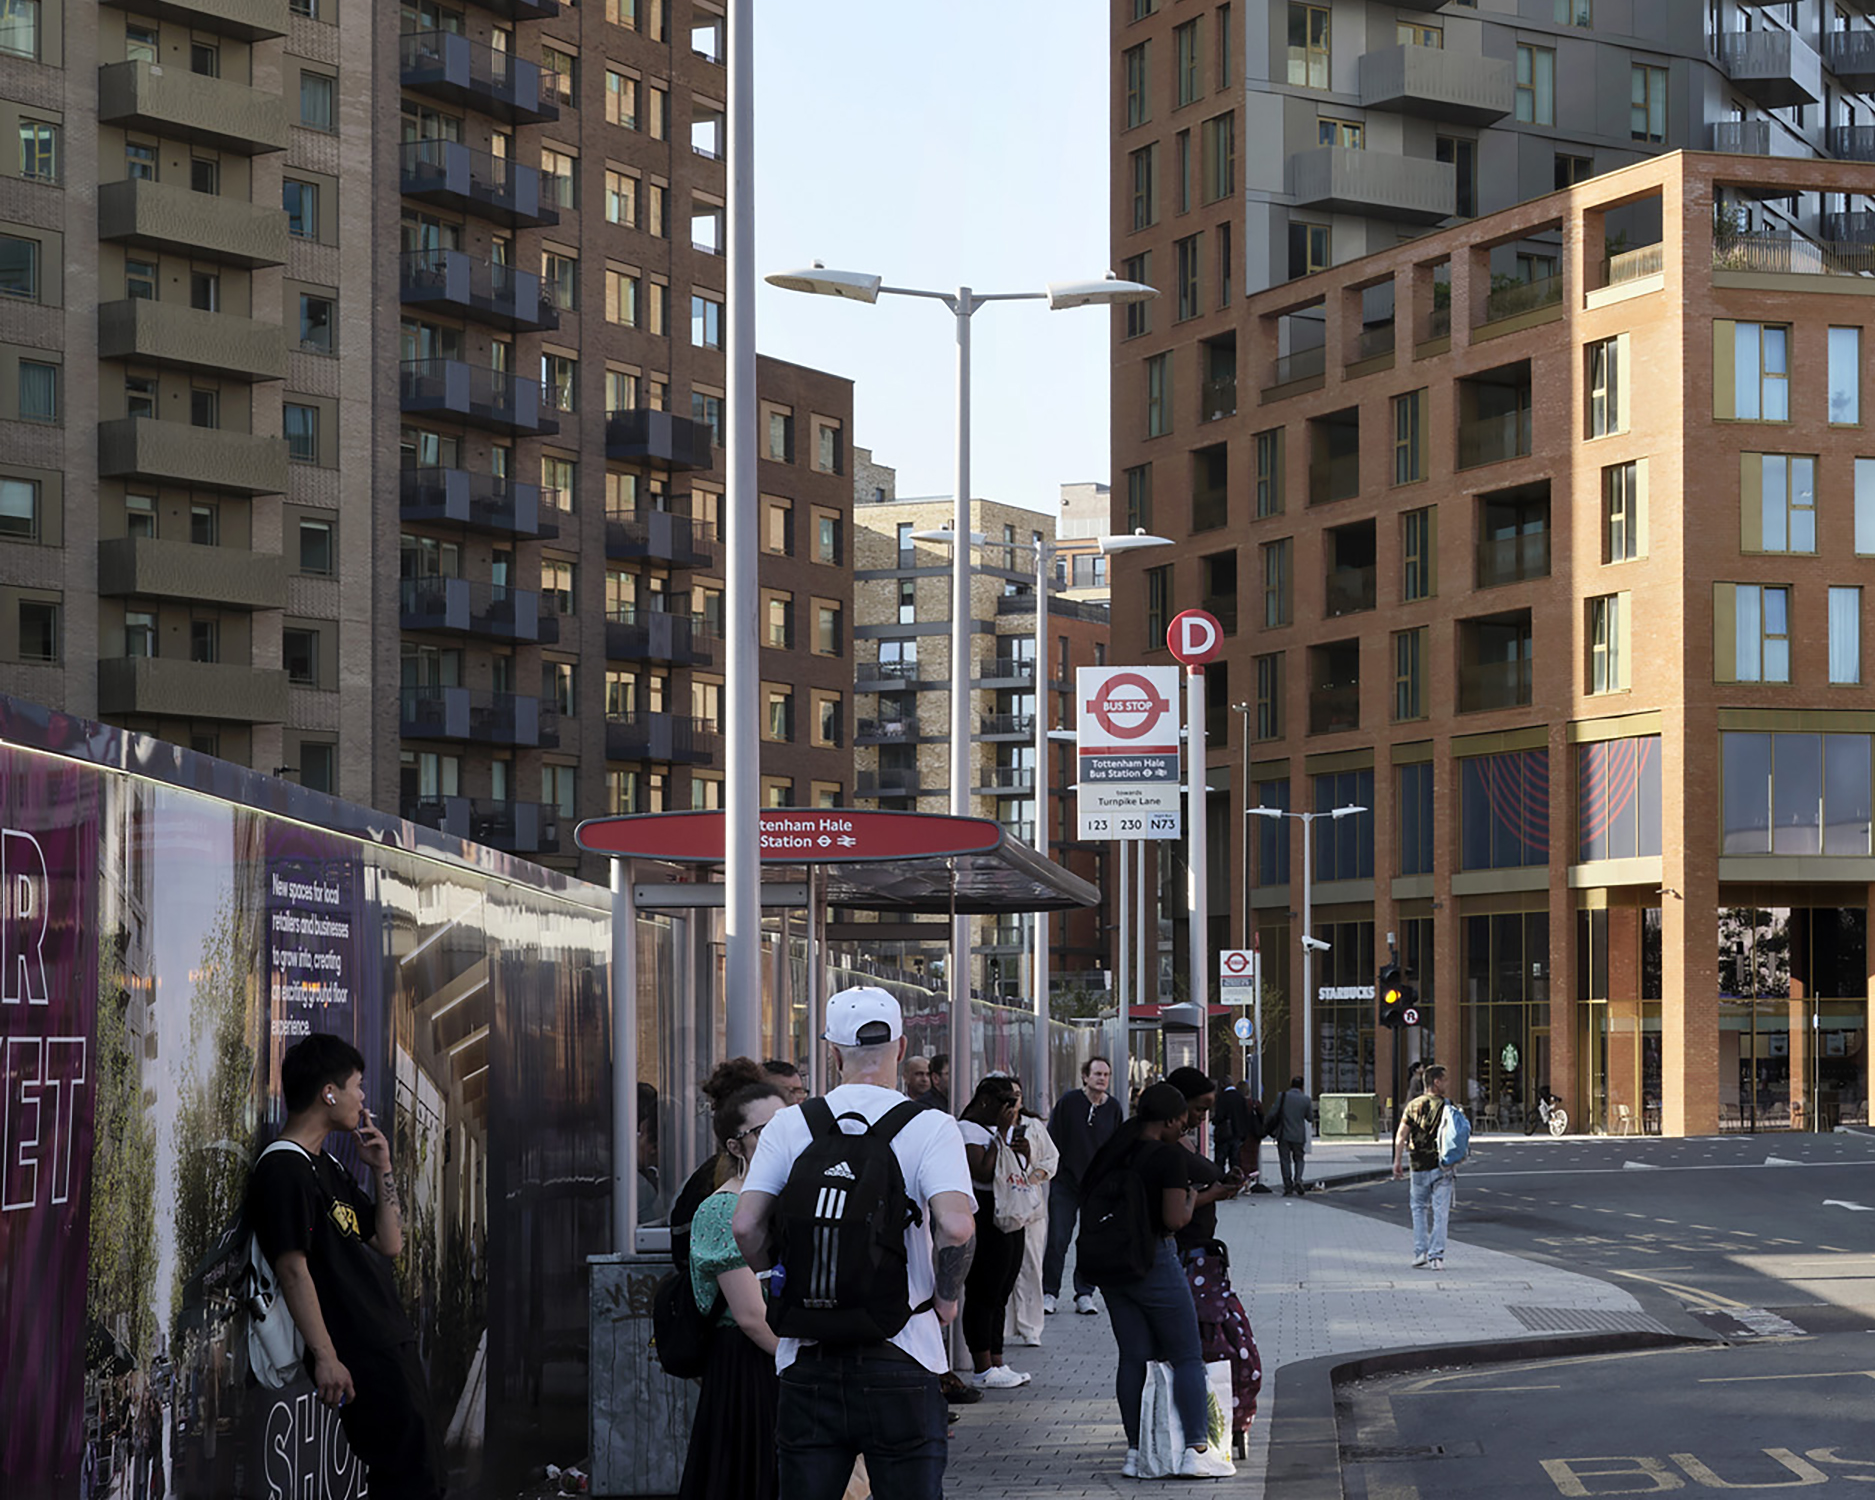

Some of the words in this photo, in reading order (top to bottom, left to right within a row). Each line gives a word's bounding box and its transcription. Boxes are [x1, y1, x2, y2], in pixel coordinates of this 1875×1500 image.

[1182, 617, 1216, 655] D
[1103, 701, 1124, 712] BUS
[1125, 701, 1153, 711] STOP
[1089, 769, 1106, 778] Bus
[1108, 769, 1140, 778] Station
[1091, 759, 1142, 768] Tottenham
[1144, 759, 1165, 768] Hale
[1098, 798, 1137, 807] Turnpike
[759, 819, 815, 831] tenham
[820, 819, 852, 831] Hale
[1088, 820, 1108, 830] 123
[1120, 820, 1142, 830] 230
[1151, 820, 1175, 829] N73
[760, 835, 812, 847] Station
[272, 873, 288, 896] New
[289, 880, 313, 904] spaces
[313, 880, 323, 901] for
[324, 881, 339, 904] local
[272, 910, 299, 933] retailers
[301, 913, 314, 934] and
[315, 913, 349, 938] businesses
[272, 946, 280, 965] to
[280, 952, 298, 973] grow
[314, 949, 342, 977] creating
[272, 986, 280, 1001] an
[281, 981, 307, 1008] exciting
[307, 982, 332, 1009] ground
[333, 982, 348, 1003] floor
[1318, 986, 1375, 1000] STARBUCKS
[271, 1015, 311, 1042] experience.
[0, 1036, 86, 1211] ET
[264, 1392, 369, 1500] SHO
